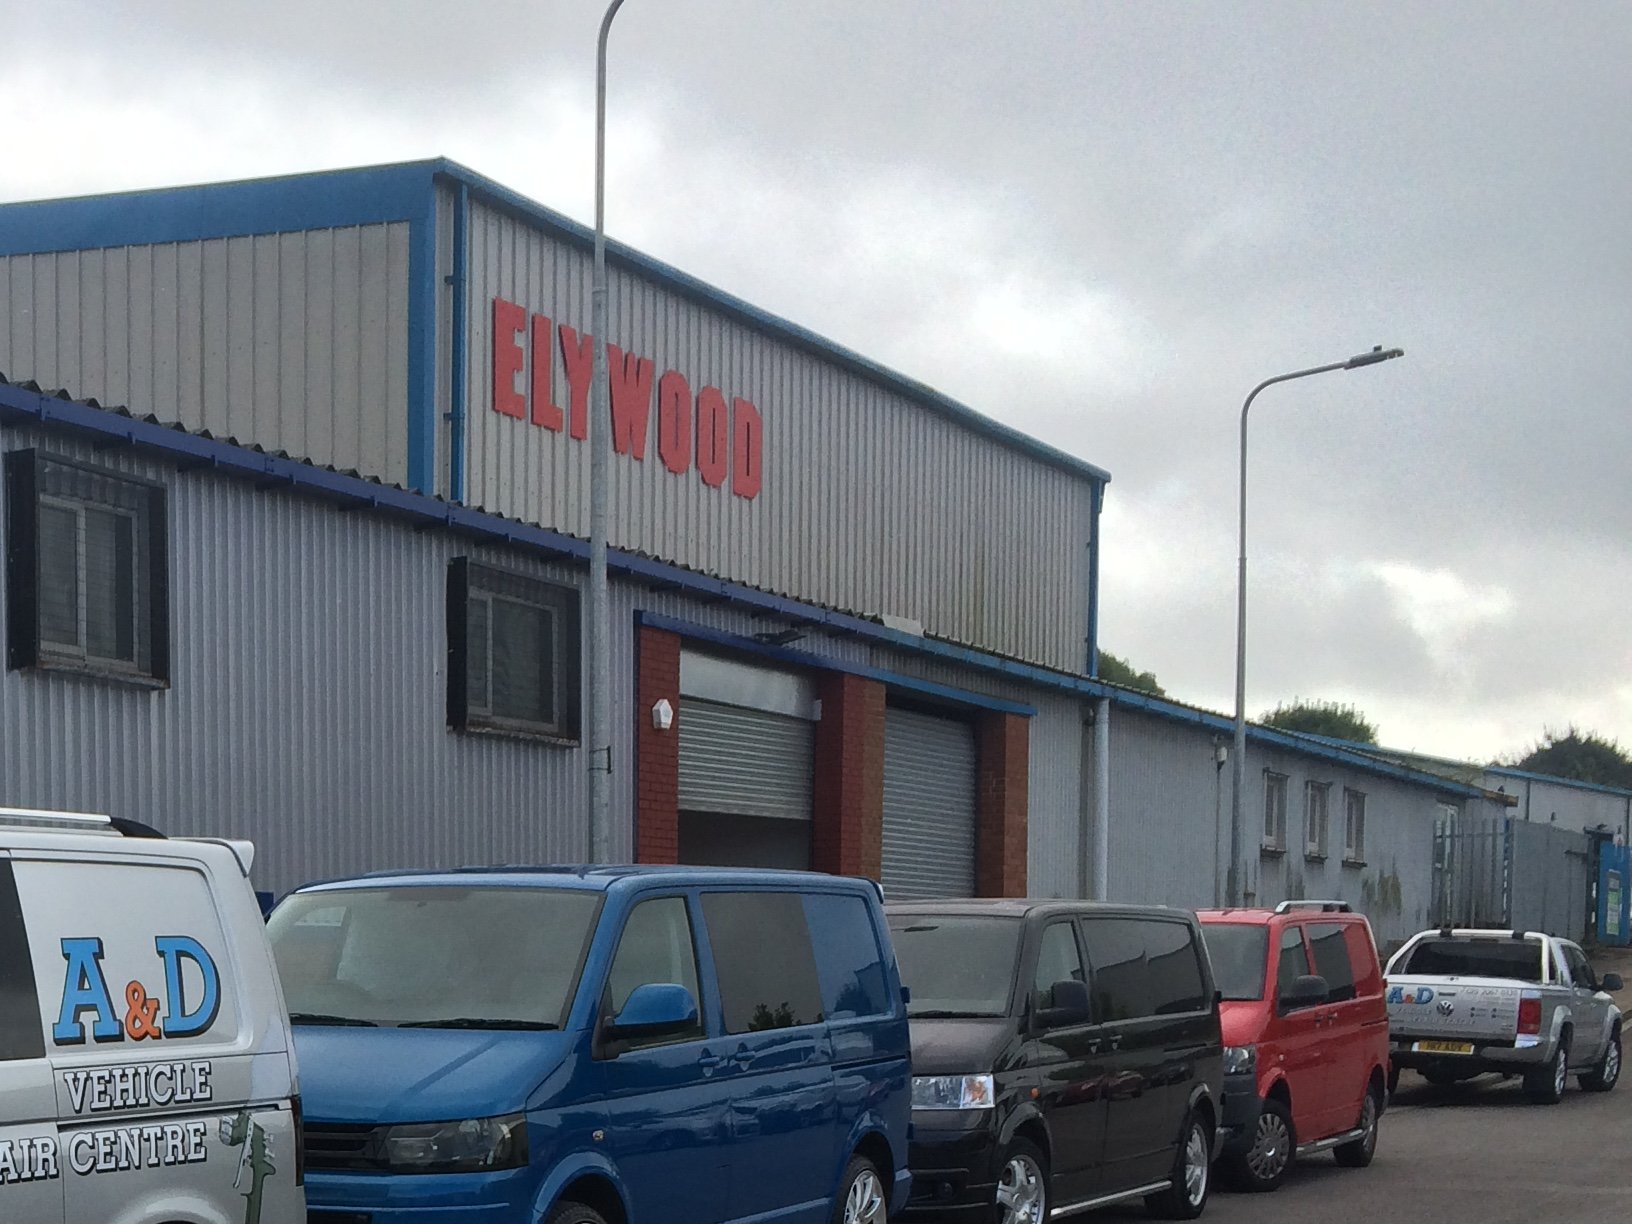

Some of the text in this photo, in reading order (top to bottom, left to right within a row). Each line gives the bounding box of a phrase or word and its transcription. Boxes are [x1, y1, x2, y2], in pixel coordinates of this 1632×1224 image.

[492, 296, 763, 500] ELYWOOD
[52, 935, 221, 1046] A&D
[64, 1060, 212, 1114] VEHICLE
[69, 1122, 208, 1178] CENTRE
